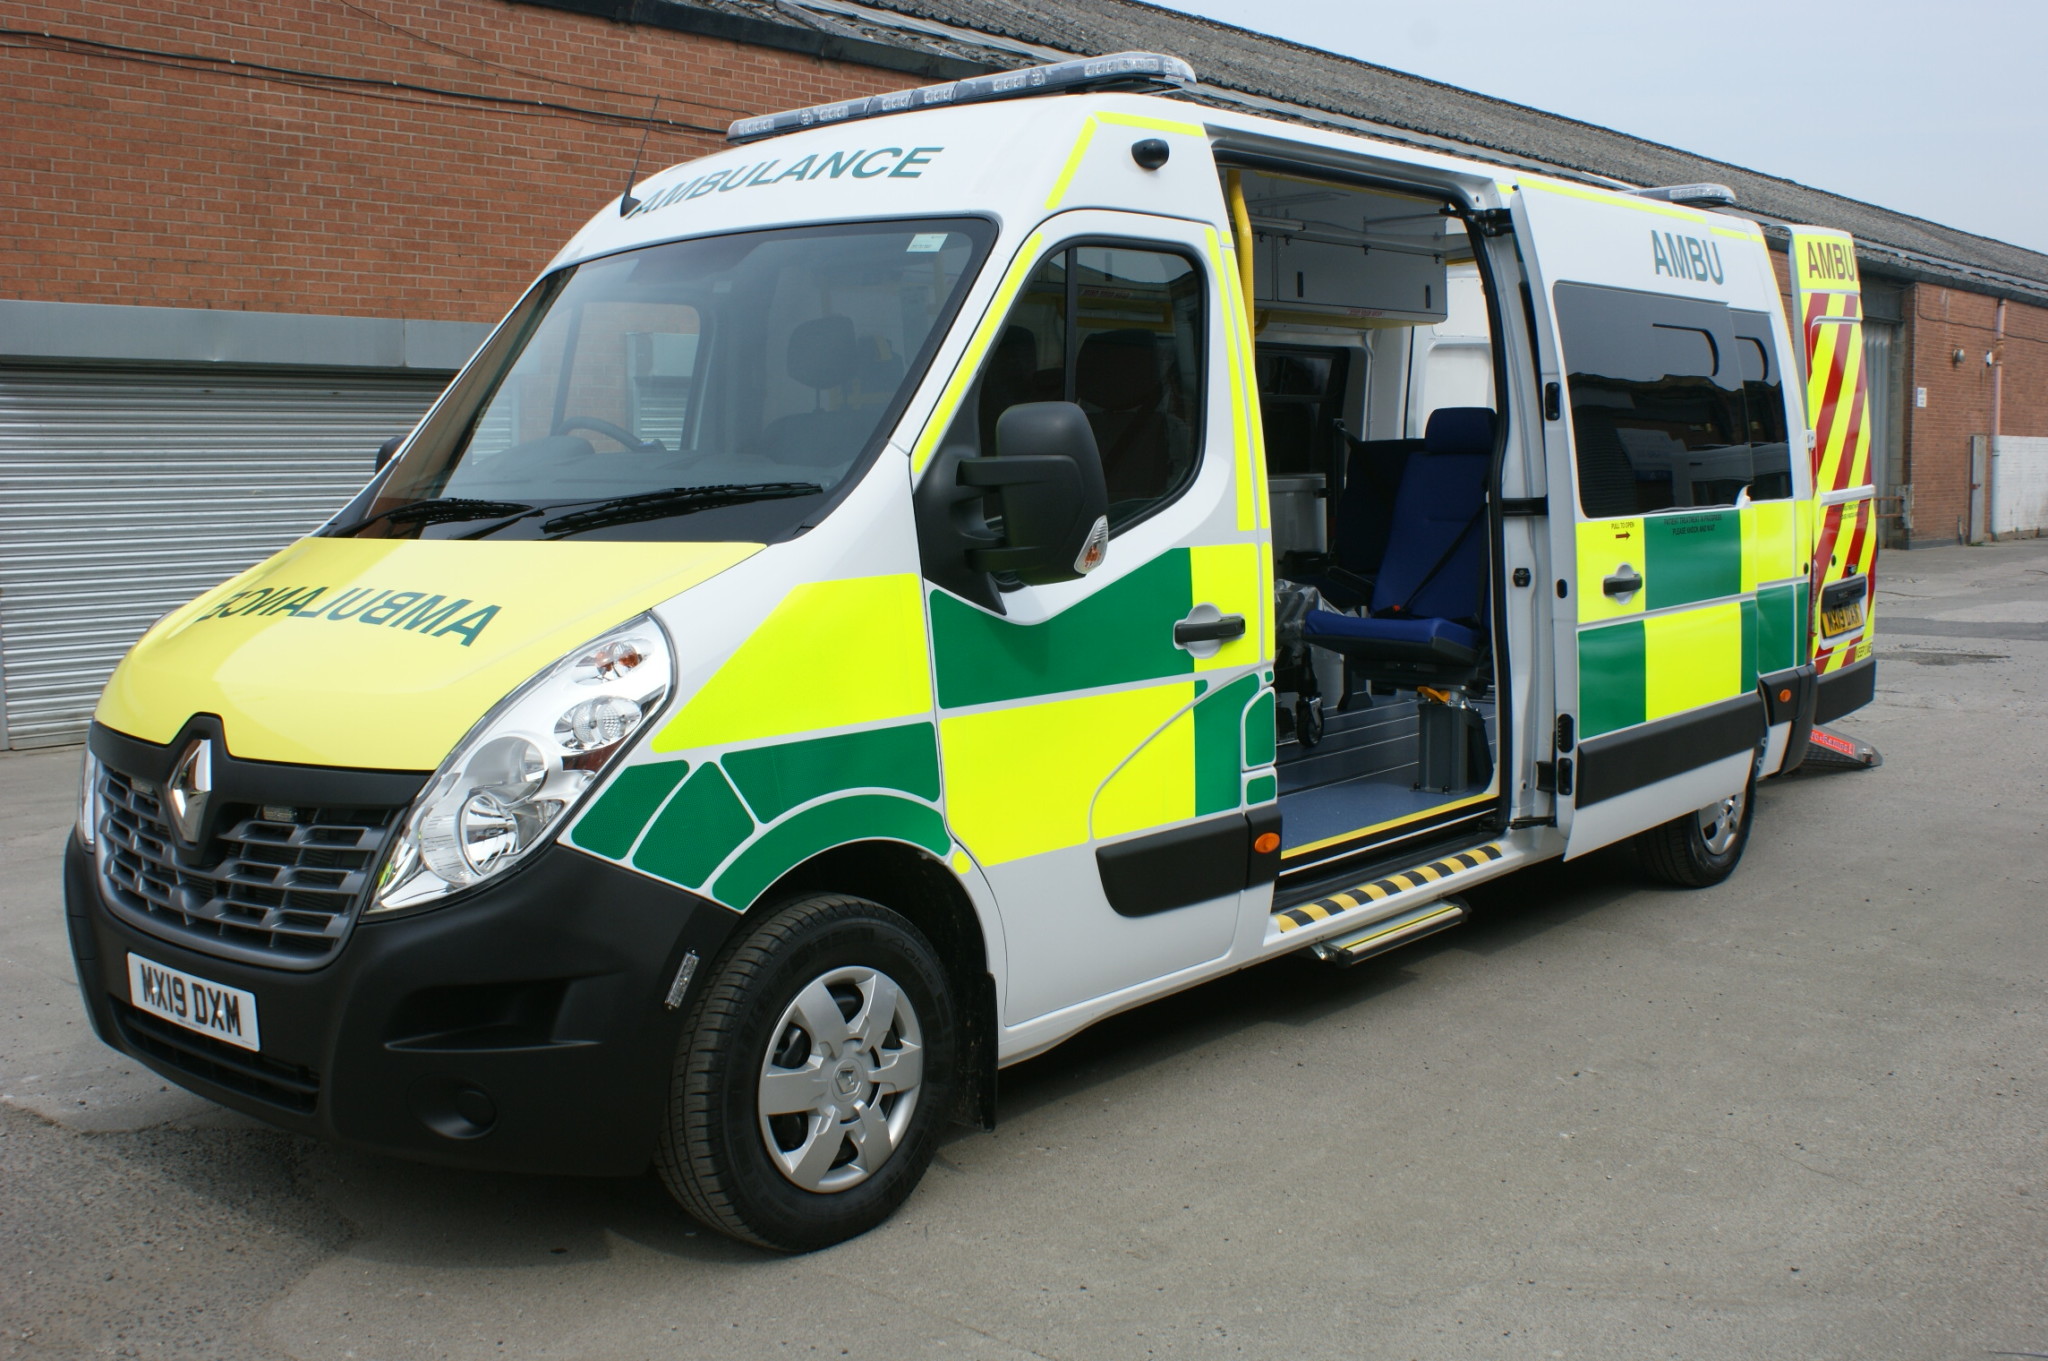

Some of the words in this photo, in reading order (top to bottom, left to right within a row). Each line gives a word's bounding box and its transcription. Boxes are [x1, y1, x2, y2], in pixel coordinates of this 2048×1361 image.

[625, 147, 945, 220] AMBULANCE
[1651, 230, 1724, 286] AMBU
[1807, 241, 1856, 282] AMBU
[141, 963, 188, 1018] MX19
[191, 982, 242, 1037] DXM
